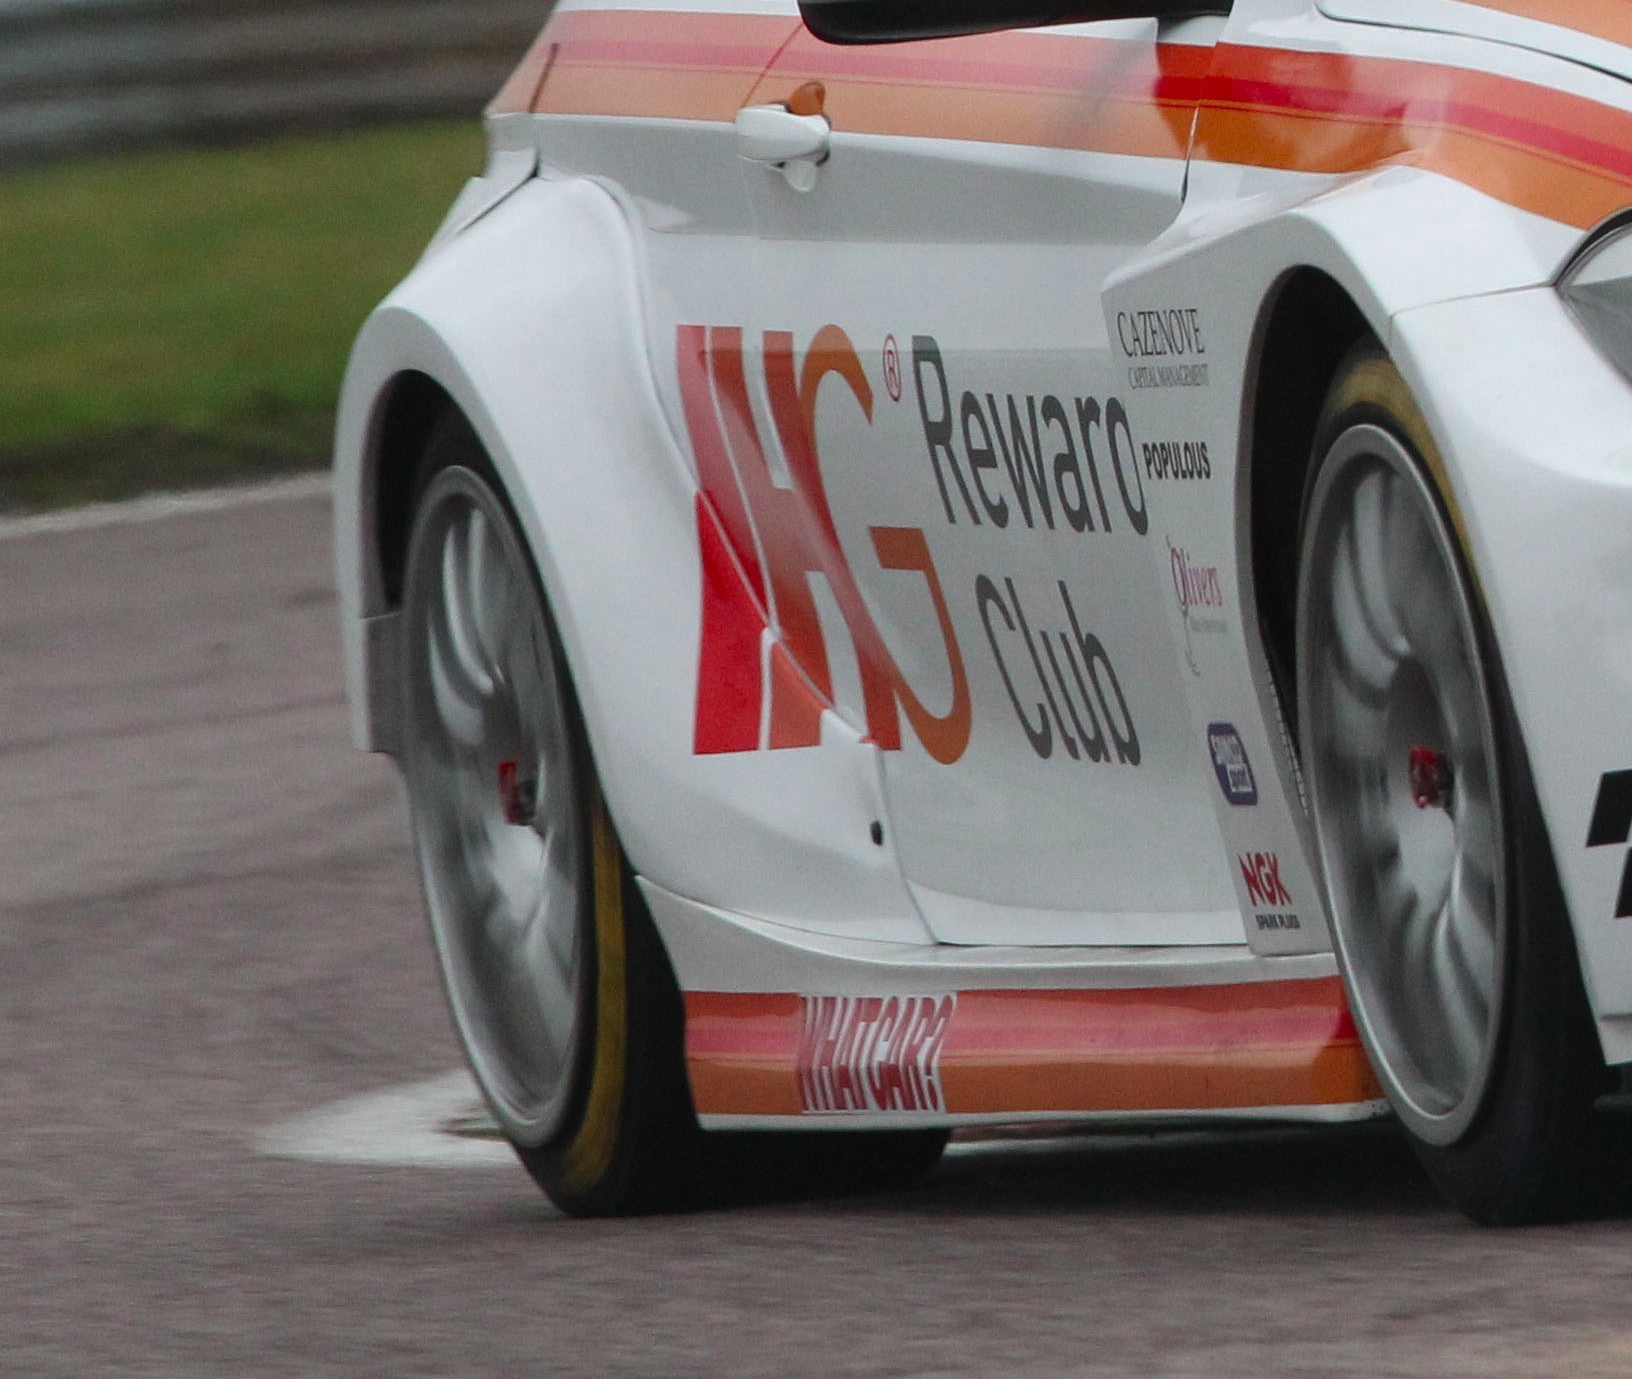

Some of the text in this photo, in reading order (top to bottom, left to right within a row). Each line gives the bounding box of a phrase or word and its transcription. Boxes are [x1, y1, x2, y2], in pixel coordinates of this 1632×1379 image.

[1117, 308, 1205, 358] CAZENOVE
[1142, 441, 1212, 480] POPULOUS
[974, 573, 1141, 767] Club
[1238, 851, 1293, 907] NGK
